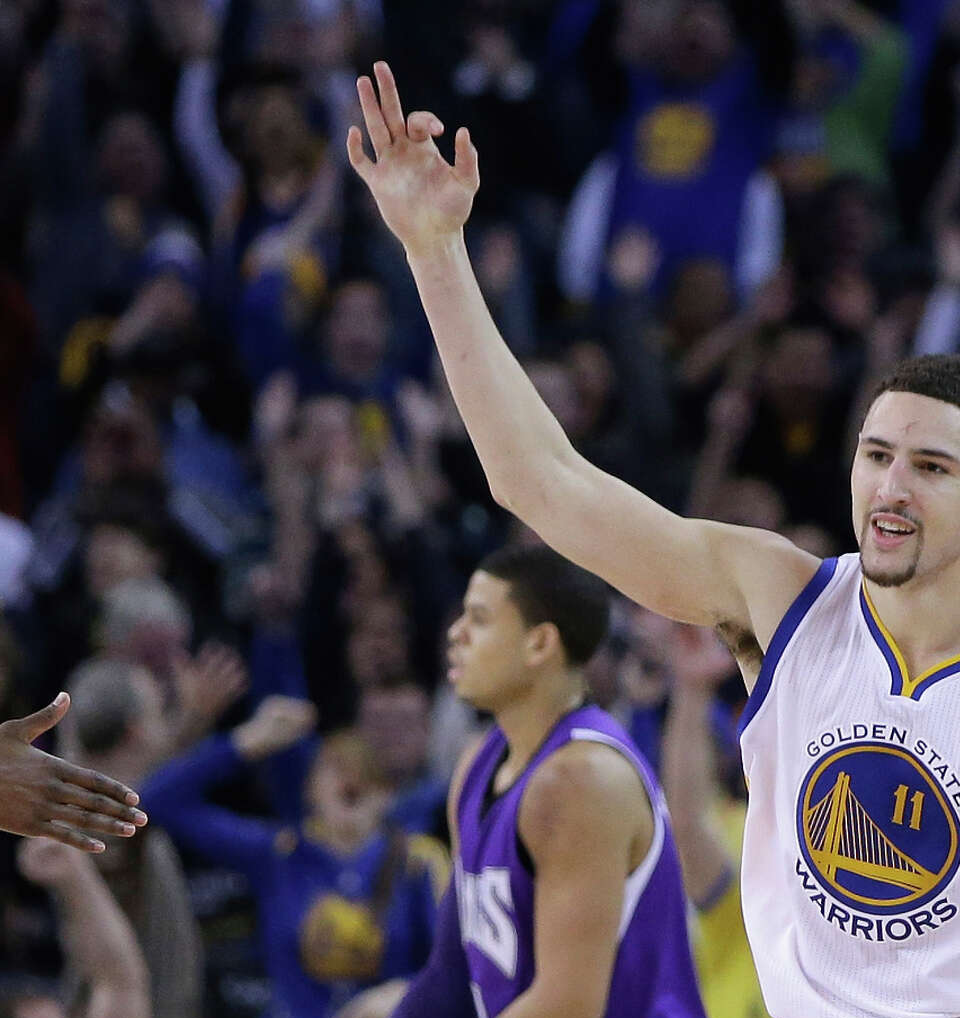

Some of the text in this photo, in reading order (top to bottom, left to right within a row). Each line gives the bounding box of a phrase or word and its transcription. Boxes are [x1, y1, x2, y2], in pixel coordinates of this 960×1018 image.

[806, 724, 907, 758] GOLDEN
[892, 784, 925, 831] 11
[796, 857, 958, 942] WARRIORS
